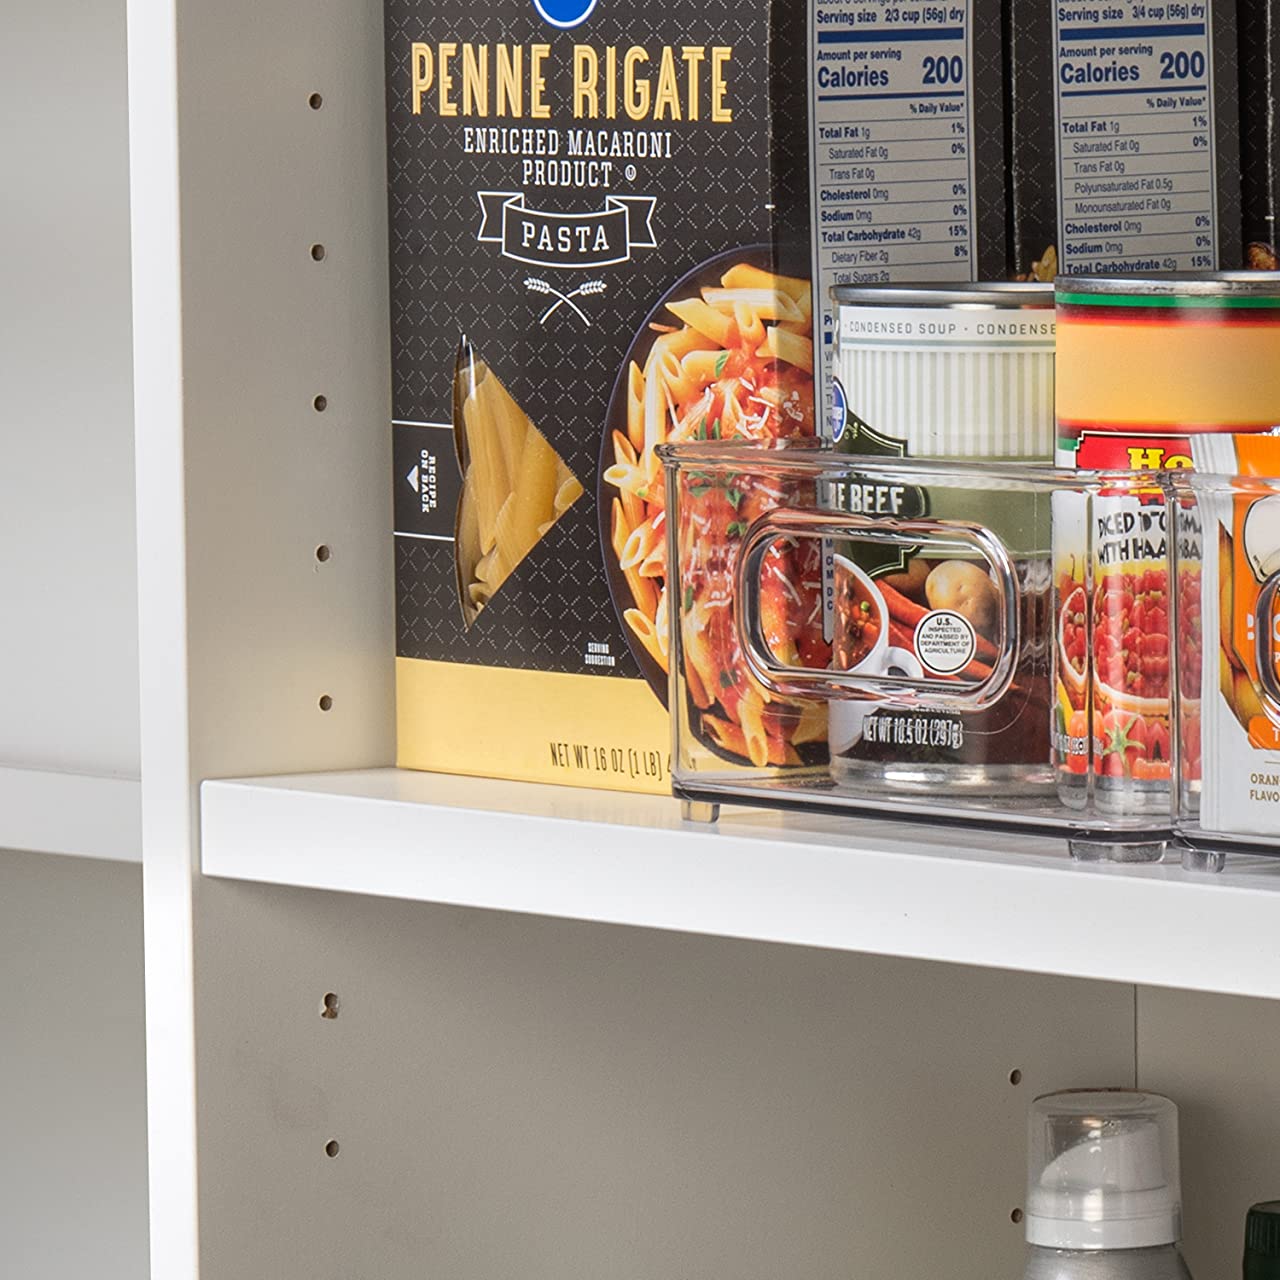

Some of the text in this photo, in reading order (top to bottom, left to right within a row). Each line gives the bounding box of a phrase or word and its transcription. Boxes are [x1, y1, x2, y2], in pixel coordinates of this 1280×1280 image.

[817, 8, 964, 25] Serving size 2/3 cup (56g) dry
[817, 49, 901, 62] Amount per serving
[1061, 51, 1205, 84] Calories 200
[411, 42, 732, 122] PENNE RIGATE
[818, 55, 963, 88] Calories 200
[464, 128, 672, 158] ENRICHED MACARONI
[819, 123, 964, 139] Total Fat 1g 1%
[523, 159, 612, 187] PRODUCT
[821, 184, 966, 201] Cholesterol 0%
[521, 221, 609, 252] PASTA
[823, 226, 967, 242] Total Carbohydrate 15%
[849, 320, 912, 334] CONDENSED
[919, 323, 955, 334] SOUP
[421, 450, 430, 512] ON BACK
[428, 456, 437, 509] RECIPE
[851, 485, 905, 514] BEEF
[936, 618, 953, 626] U.S.
[550, 742, 662, 780] NET WT 16 OZ (1 LB)
